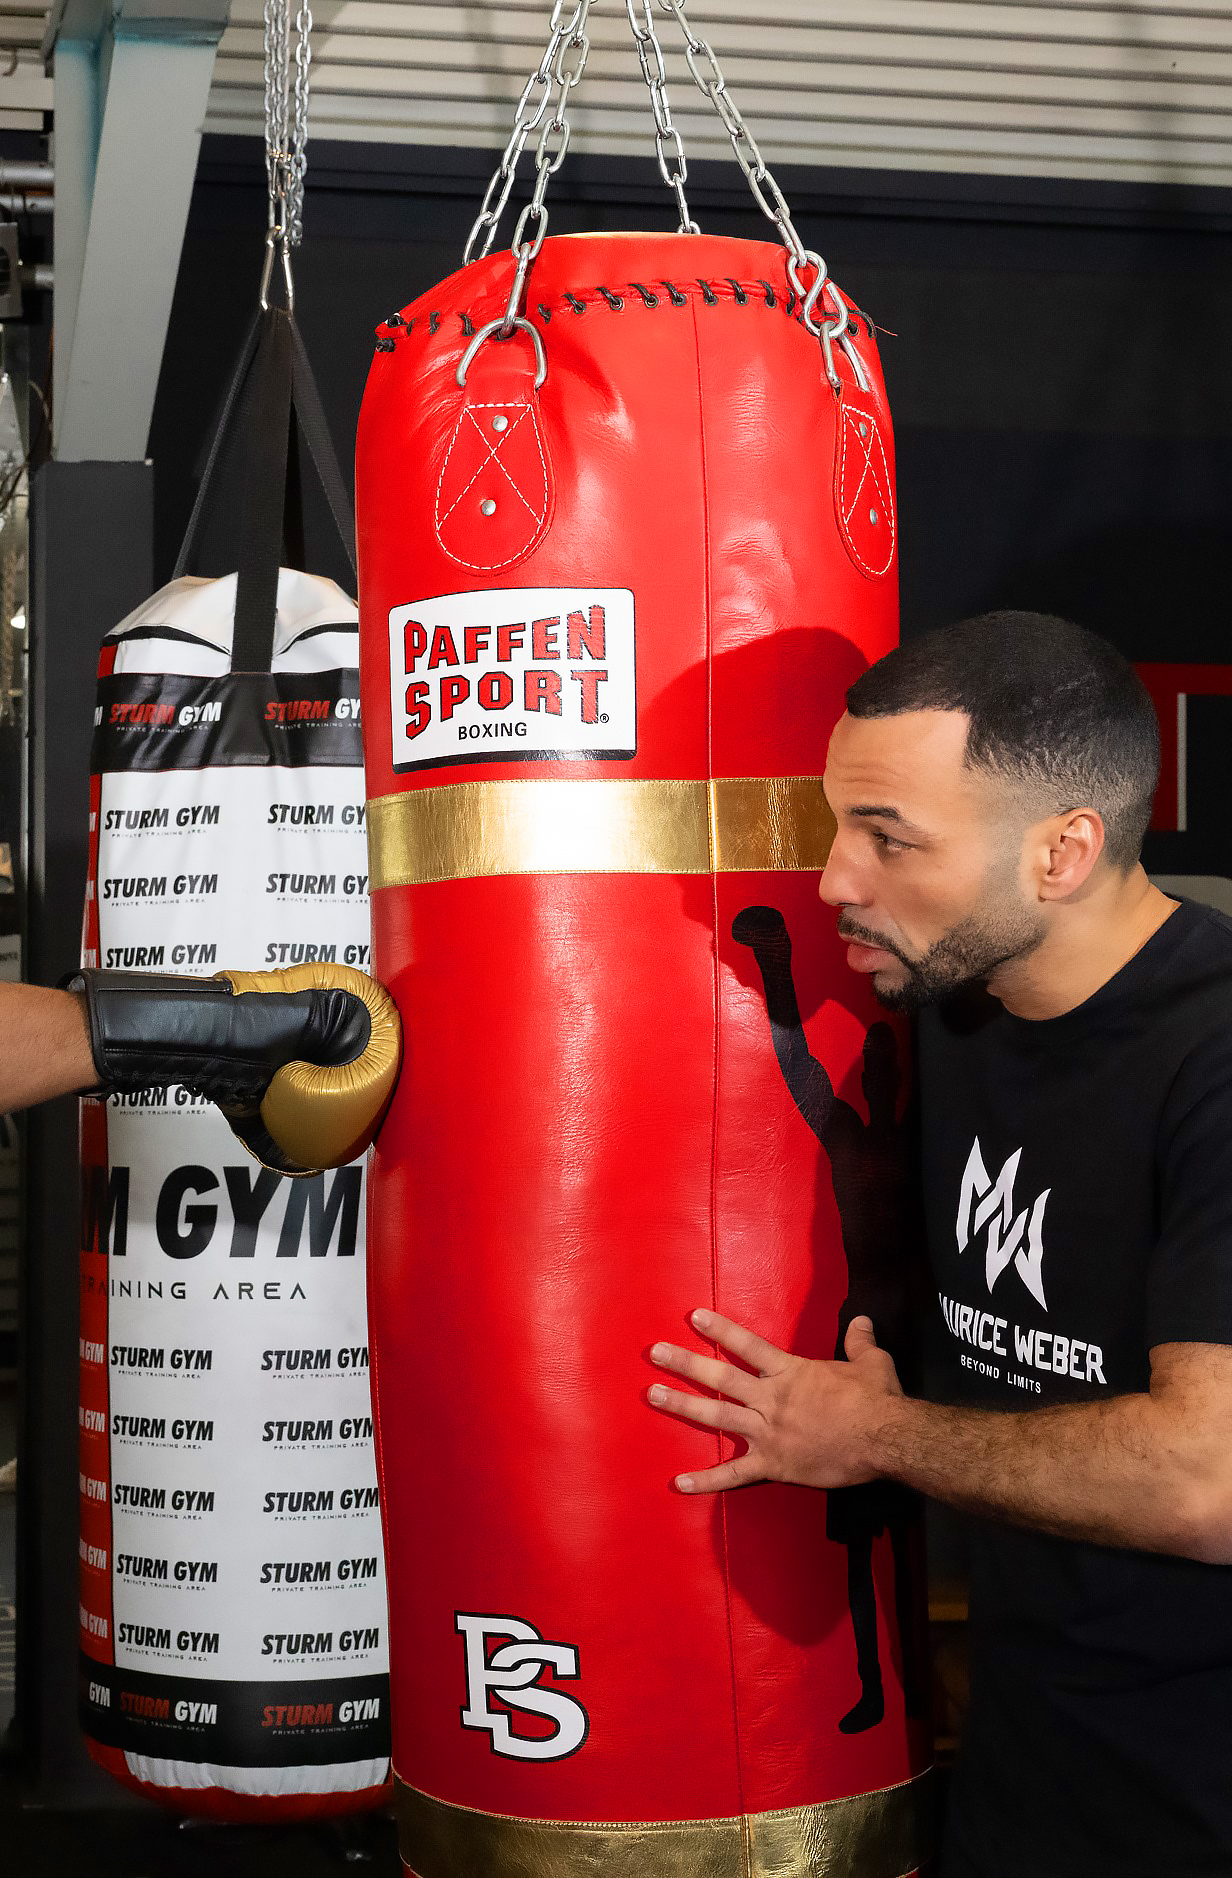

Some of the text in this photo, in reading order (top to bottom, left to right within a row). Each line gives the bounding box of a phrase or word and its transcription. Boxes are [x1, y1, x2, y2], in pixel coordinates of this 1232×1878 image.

[404, 604, 606, 675] PAFFEN
[109, 703, 176, 724] STURM
[178, 701, 222, 726] GYM
[264, 698, 361, 722] STURM GY
[458, 722, 527, 740] BOXING
[105, 808, 169, 830] STURM
[176, 805, 221, 827] GYM
[267, 804, 366, 826] STURM GY
[103, 877, 168, 900] STURM
[173, 874, 219, 895] GYM
[265, 873, 369, 895] STURM GY
[106, 946, 165, 968] STURM
[171, 944, 217, 965] GYM
[264, 943, 370, 965] STURM GY
[155, 1165, 363, 1260] GYM
[212, 1282, 307, 1300] AREA
[938, 1292, 1108, 1385] AURICE WEBER
[110, 1346, 165, 1369] STURM
[170, 1349, 213, 1371] GYM
[260, 1349, 331, 1371] STURM
[960, 1354, 1042, 1394] BEYOND LIMITS
[112, 1415, 166, 1439] STURM
[171, 1419, 214, 1441] GYM
[262, 1420, 333, 1442] STURM
[114, 1484, 215, 1512] STURM GYM
[263, 1487, 379, 1513] STURM GYM
[116, 1554, 218, 1583] STURM GYM
[260, 1557, 377, 1584] STURM GYM
[118, 1623, 220, 1653] STURM GYM
[261, 1627, 379, 1655] STURM GYM
[89, 1682, 111, 1707] GYM
[454, 1610, 590, 1763] PS
[120, 1691, 218, 1725] STURM GYM
[261, 1698, 380, 1728] STURM GYM
